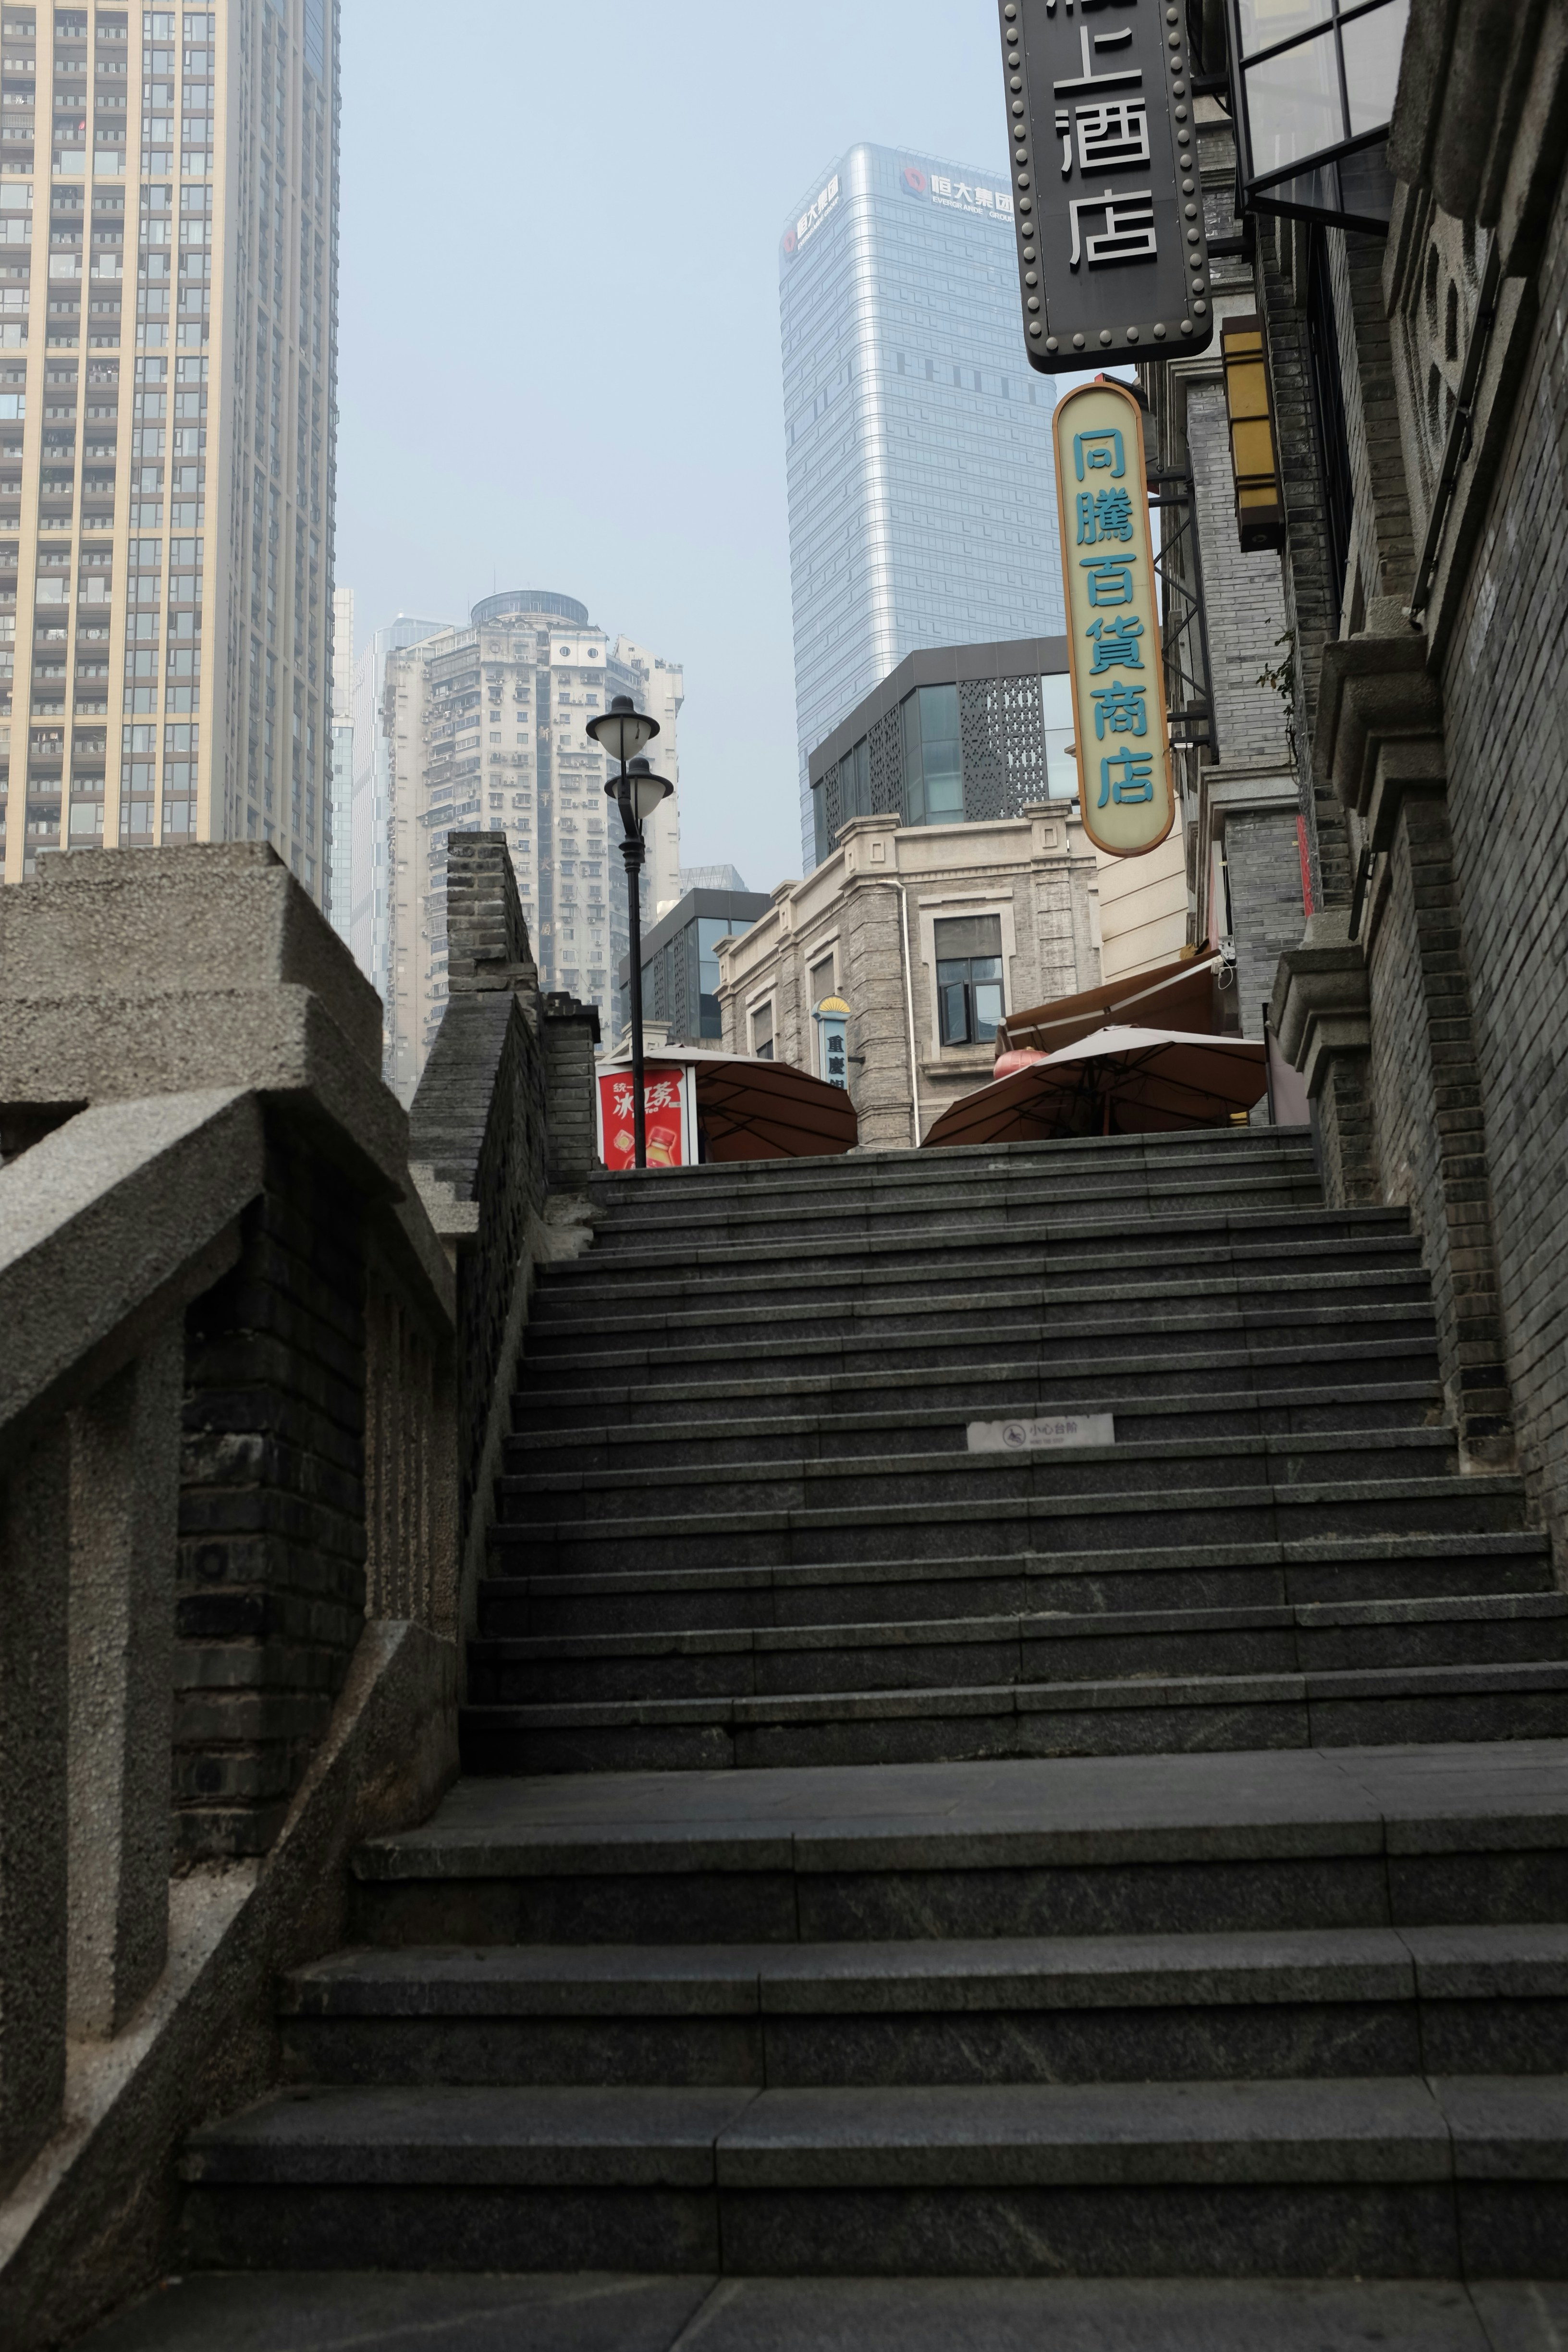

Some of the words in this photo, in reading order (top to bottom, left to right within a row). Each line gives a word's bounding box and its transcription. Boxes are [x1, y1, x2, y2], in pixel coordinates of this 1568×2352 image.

[1046, 0, 1157, 266] 上酒店
[824, 196, 839, 217] GROUP
[931, 174, 1014, 214] 恒大集团
[932, 196, 983, 215] EVERGRANDE
[989, 211, 1016, 223] GROUP
[1029, 1421, 1078, 1436] 小心台阶
